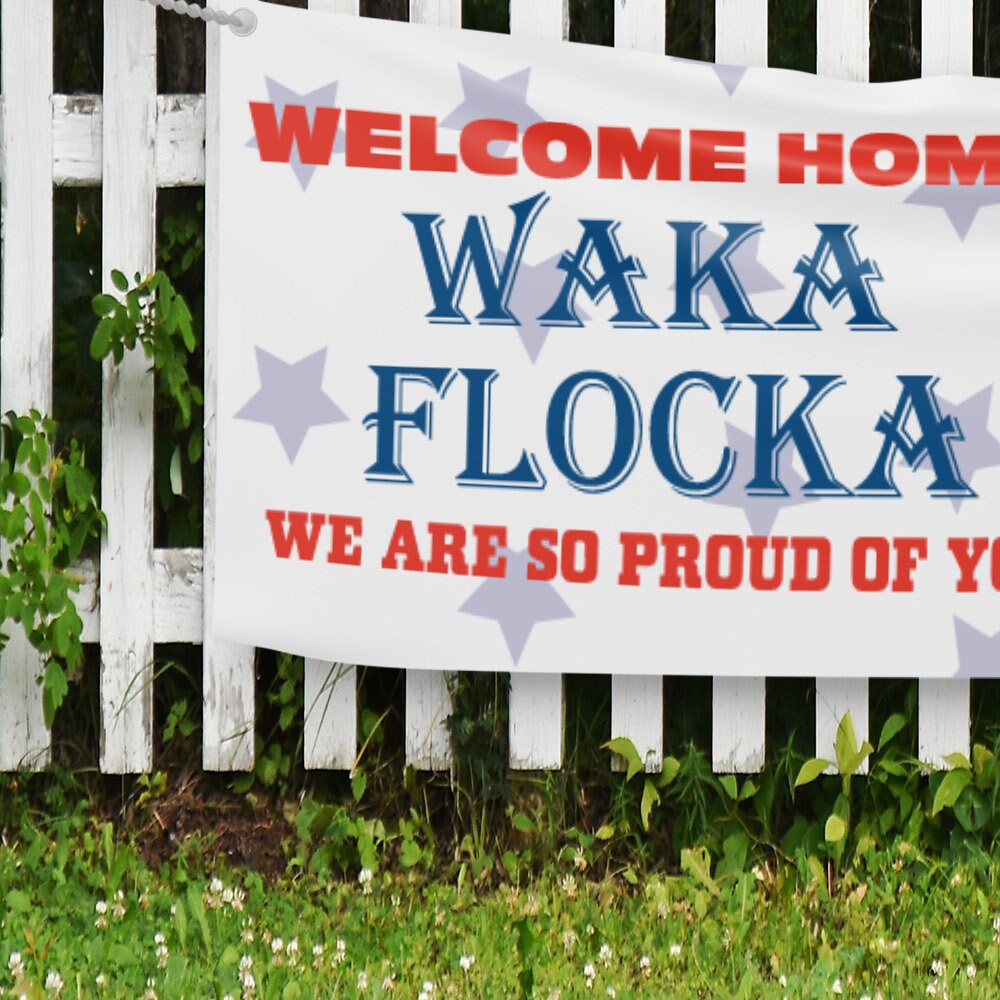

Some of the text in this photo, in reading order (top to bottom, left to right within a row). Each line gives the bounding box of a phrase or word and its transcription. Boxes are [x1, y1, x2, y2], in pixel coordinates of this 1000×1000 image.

[249, 102, 747, 184] WELCOME
[403, 192, 898, 332] WAKA
[363, 366, 979, 500] FLOCKA
[265, 510, 364, 568] WE
[382, 517, 509, 580] ARE
[527, 528, 600, 585] SO
[617, 532, 833, 593] PROUD
[852, 537, 930, 594] OF
